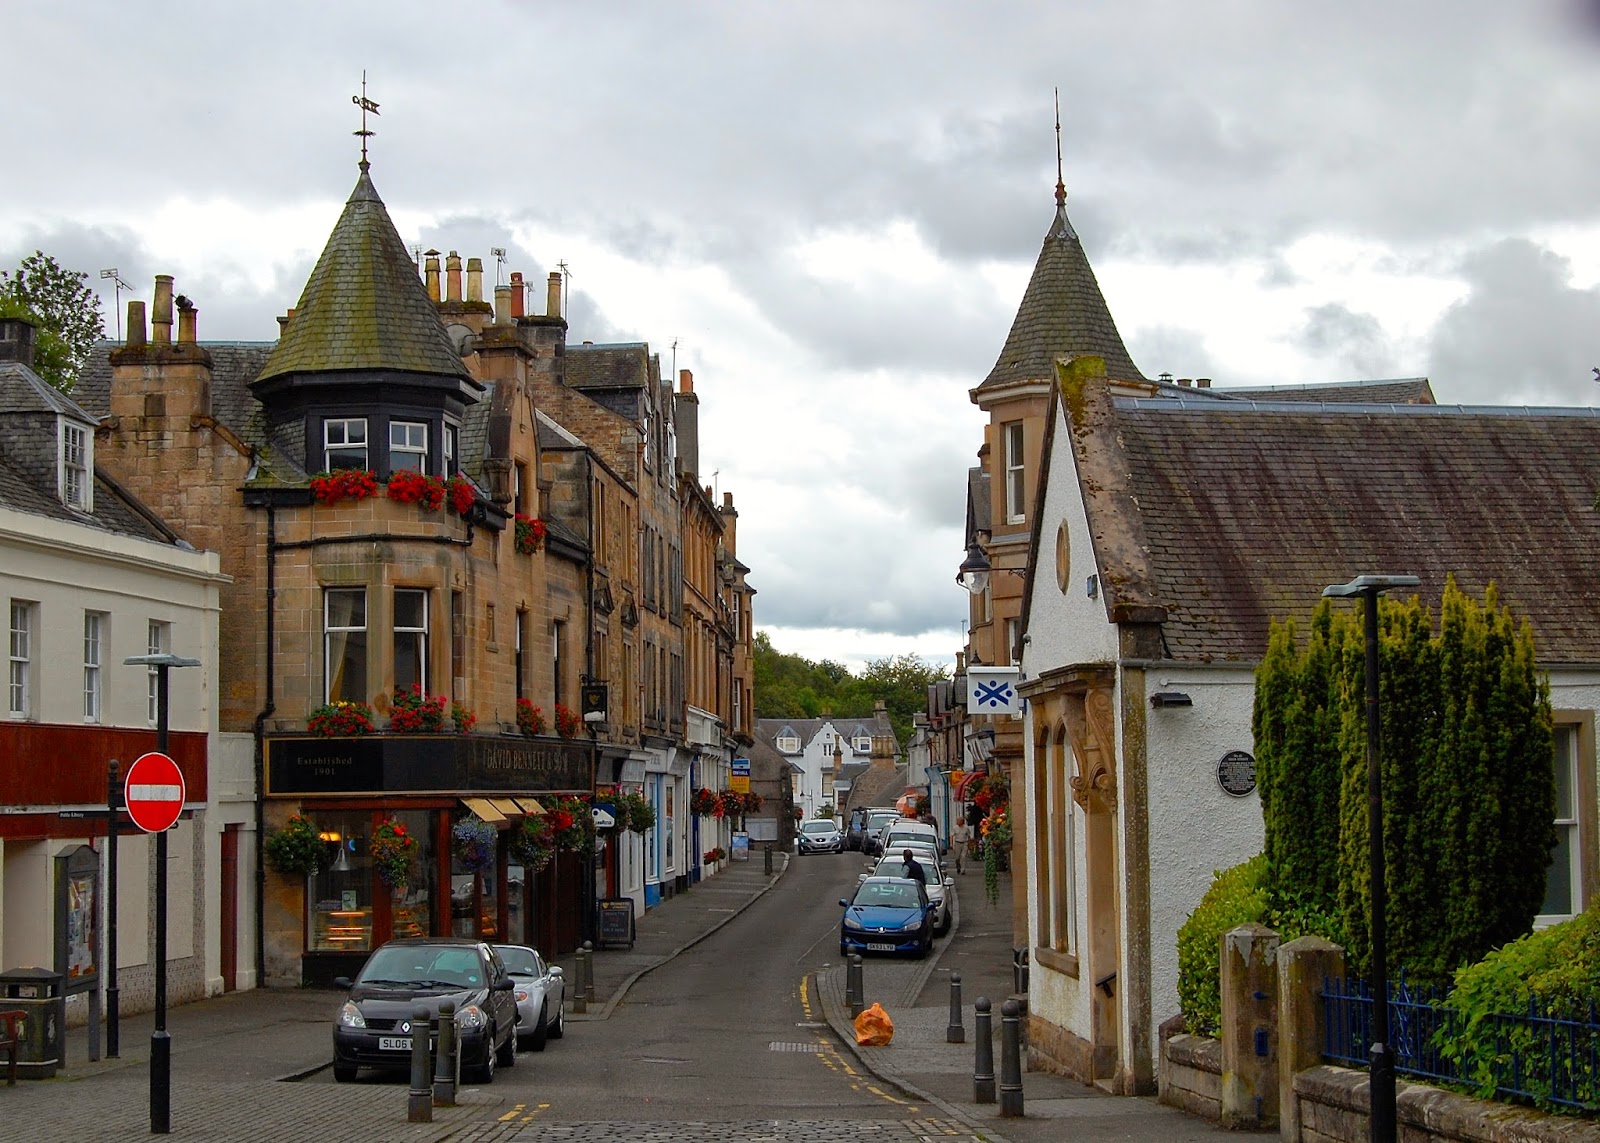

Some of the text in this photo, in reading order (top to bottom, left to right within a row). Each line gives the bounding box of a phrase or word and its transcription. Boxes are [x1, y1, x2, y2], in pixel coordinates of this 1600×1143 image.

[297, 757, 352, 765] Established
[487, 748, 511, 769] DAVID
[513, 750, 545, 770] BENNETT
[314, 767, 336, 776] 1901
[383, 1039, 408, 1049] SL06
